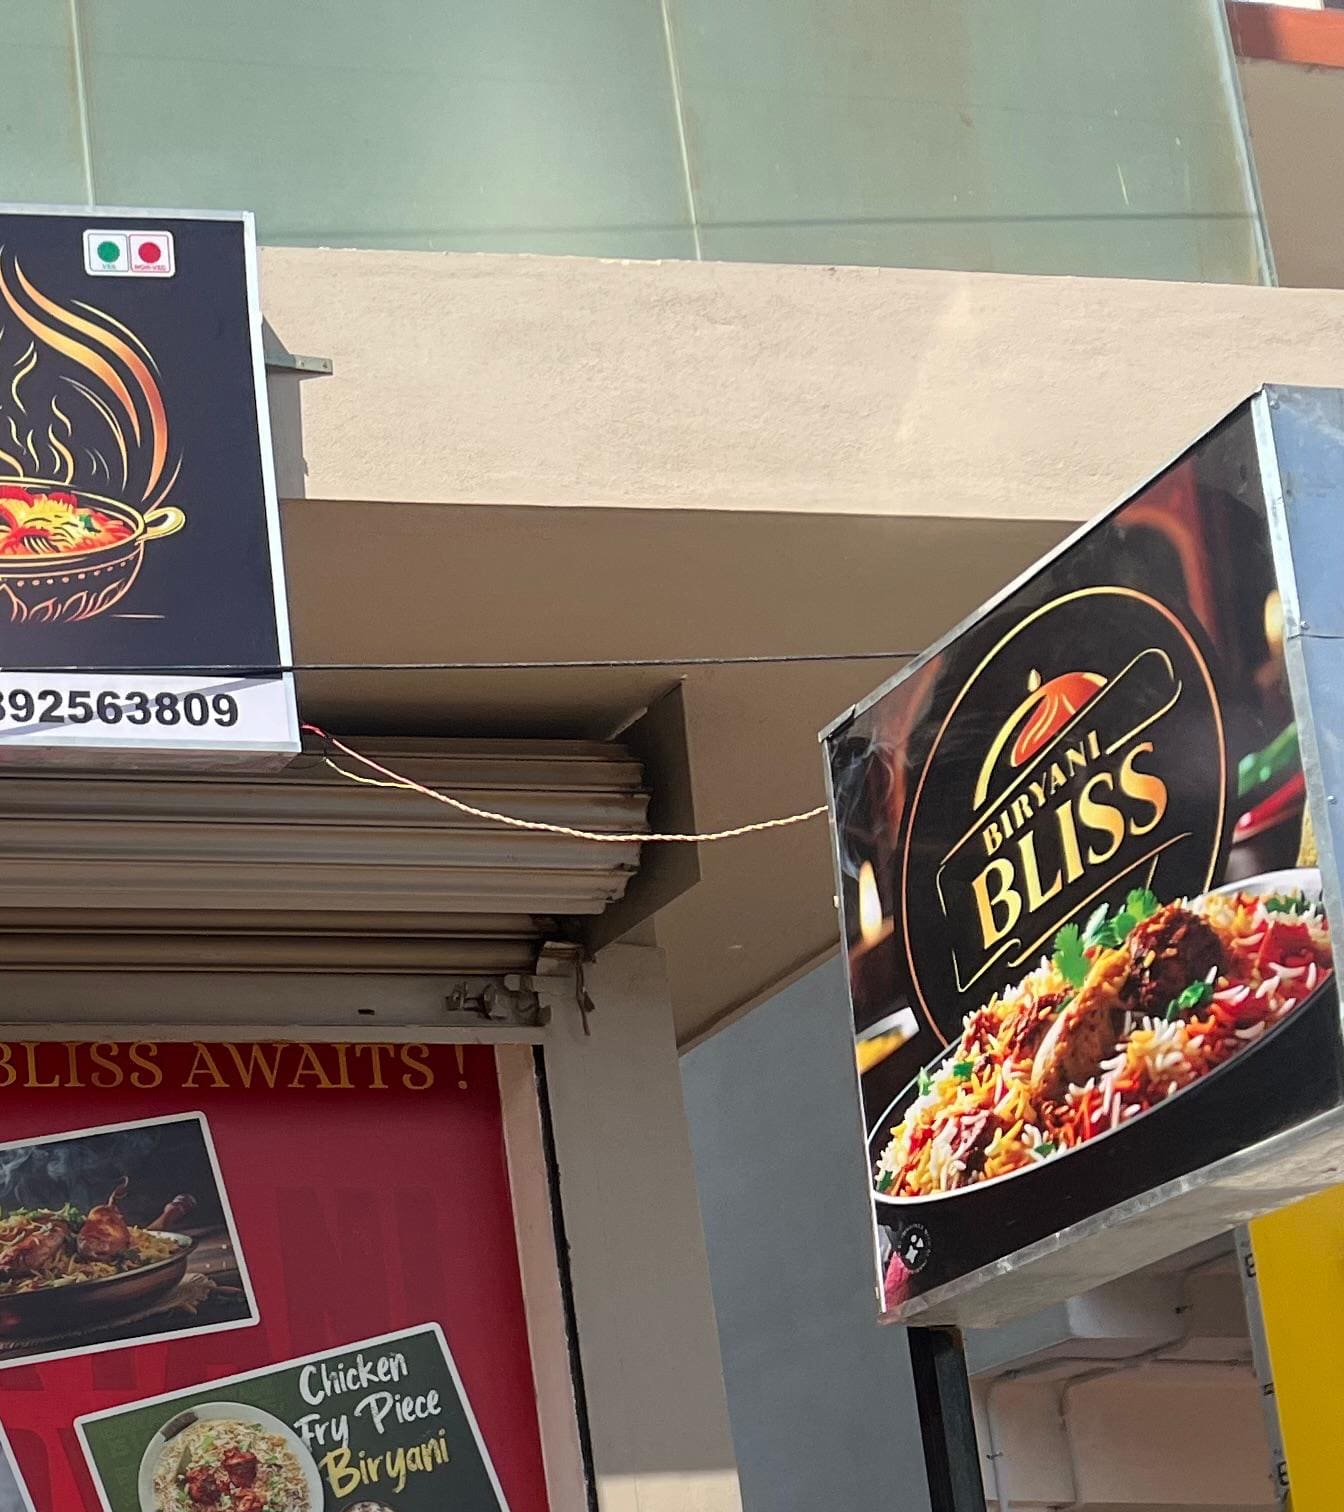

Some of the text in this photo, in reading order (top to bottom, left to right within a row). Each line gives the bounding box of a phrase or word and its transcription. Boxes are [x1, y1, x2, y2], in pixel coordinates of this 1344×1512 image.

[982, 729, 1102, 853] BIRYANI
[972, 741, 1169, 948] BLISS
[181, 1042, 435, 1090] AWAITS
[299, 1353, 408, 1405] Chicken
[293, 1390, 442, 1450] Fry Piece
[319, 1428, 450, 1498] Biryani
